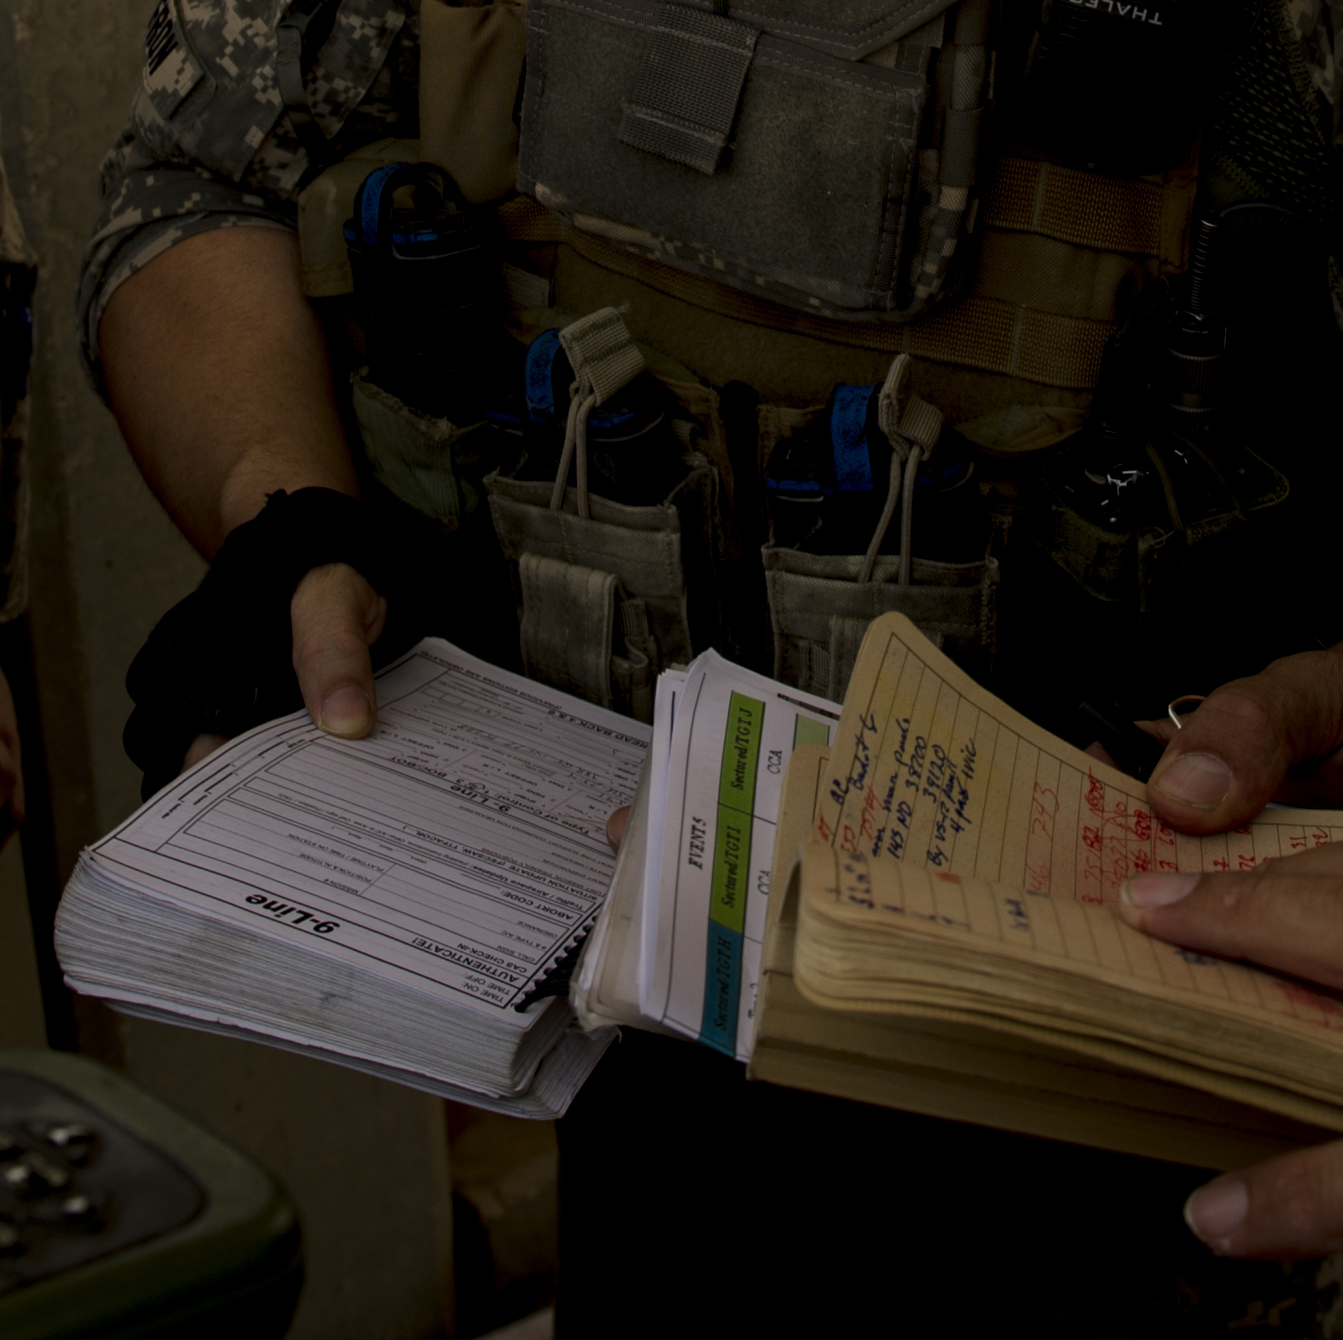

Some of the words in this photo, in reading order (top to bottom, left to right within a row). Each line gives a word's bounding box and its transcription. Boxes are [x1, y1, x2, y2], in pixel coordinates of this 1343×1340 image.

[766, 749, 783, 775] CCA
[492, 792, 544, 814] Control:
[559, 820, 590, 834] Type
[508, 865, 547, 881] UPDATE
[509, 879, 550, 896] Airspace
[757, 869, 770, 896] CCA
[499, 889, 534, 905] CODE:
[554, 896, 584, 909] Traffic
[245, 893, 341, 935] 9-Line
[534, 903, 574, 920] ABORT
[410, 937, 520, 983] AUTHENTICATE!
[456, 942, 505, 964] CHECK-IN
[504, 961, 528, 973] CAS
[460, 981, 480, 992] ON:
[462, 972, 486, 985] OFF:
[479, 989, 505, 1002] TIME
[486, 982, 511, 995] TIME
